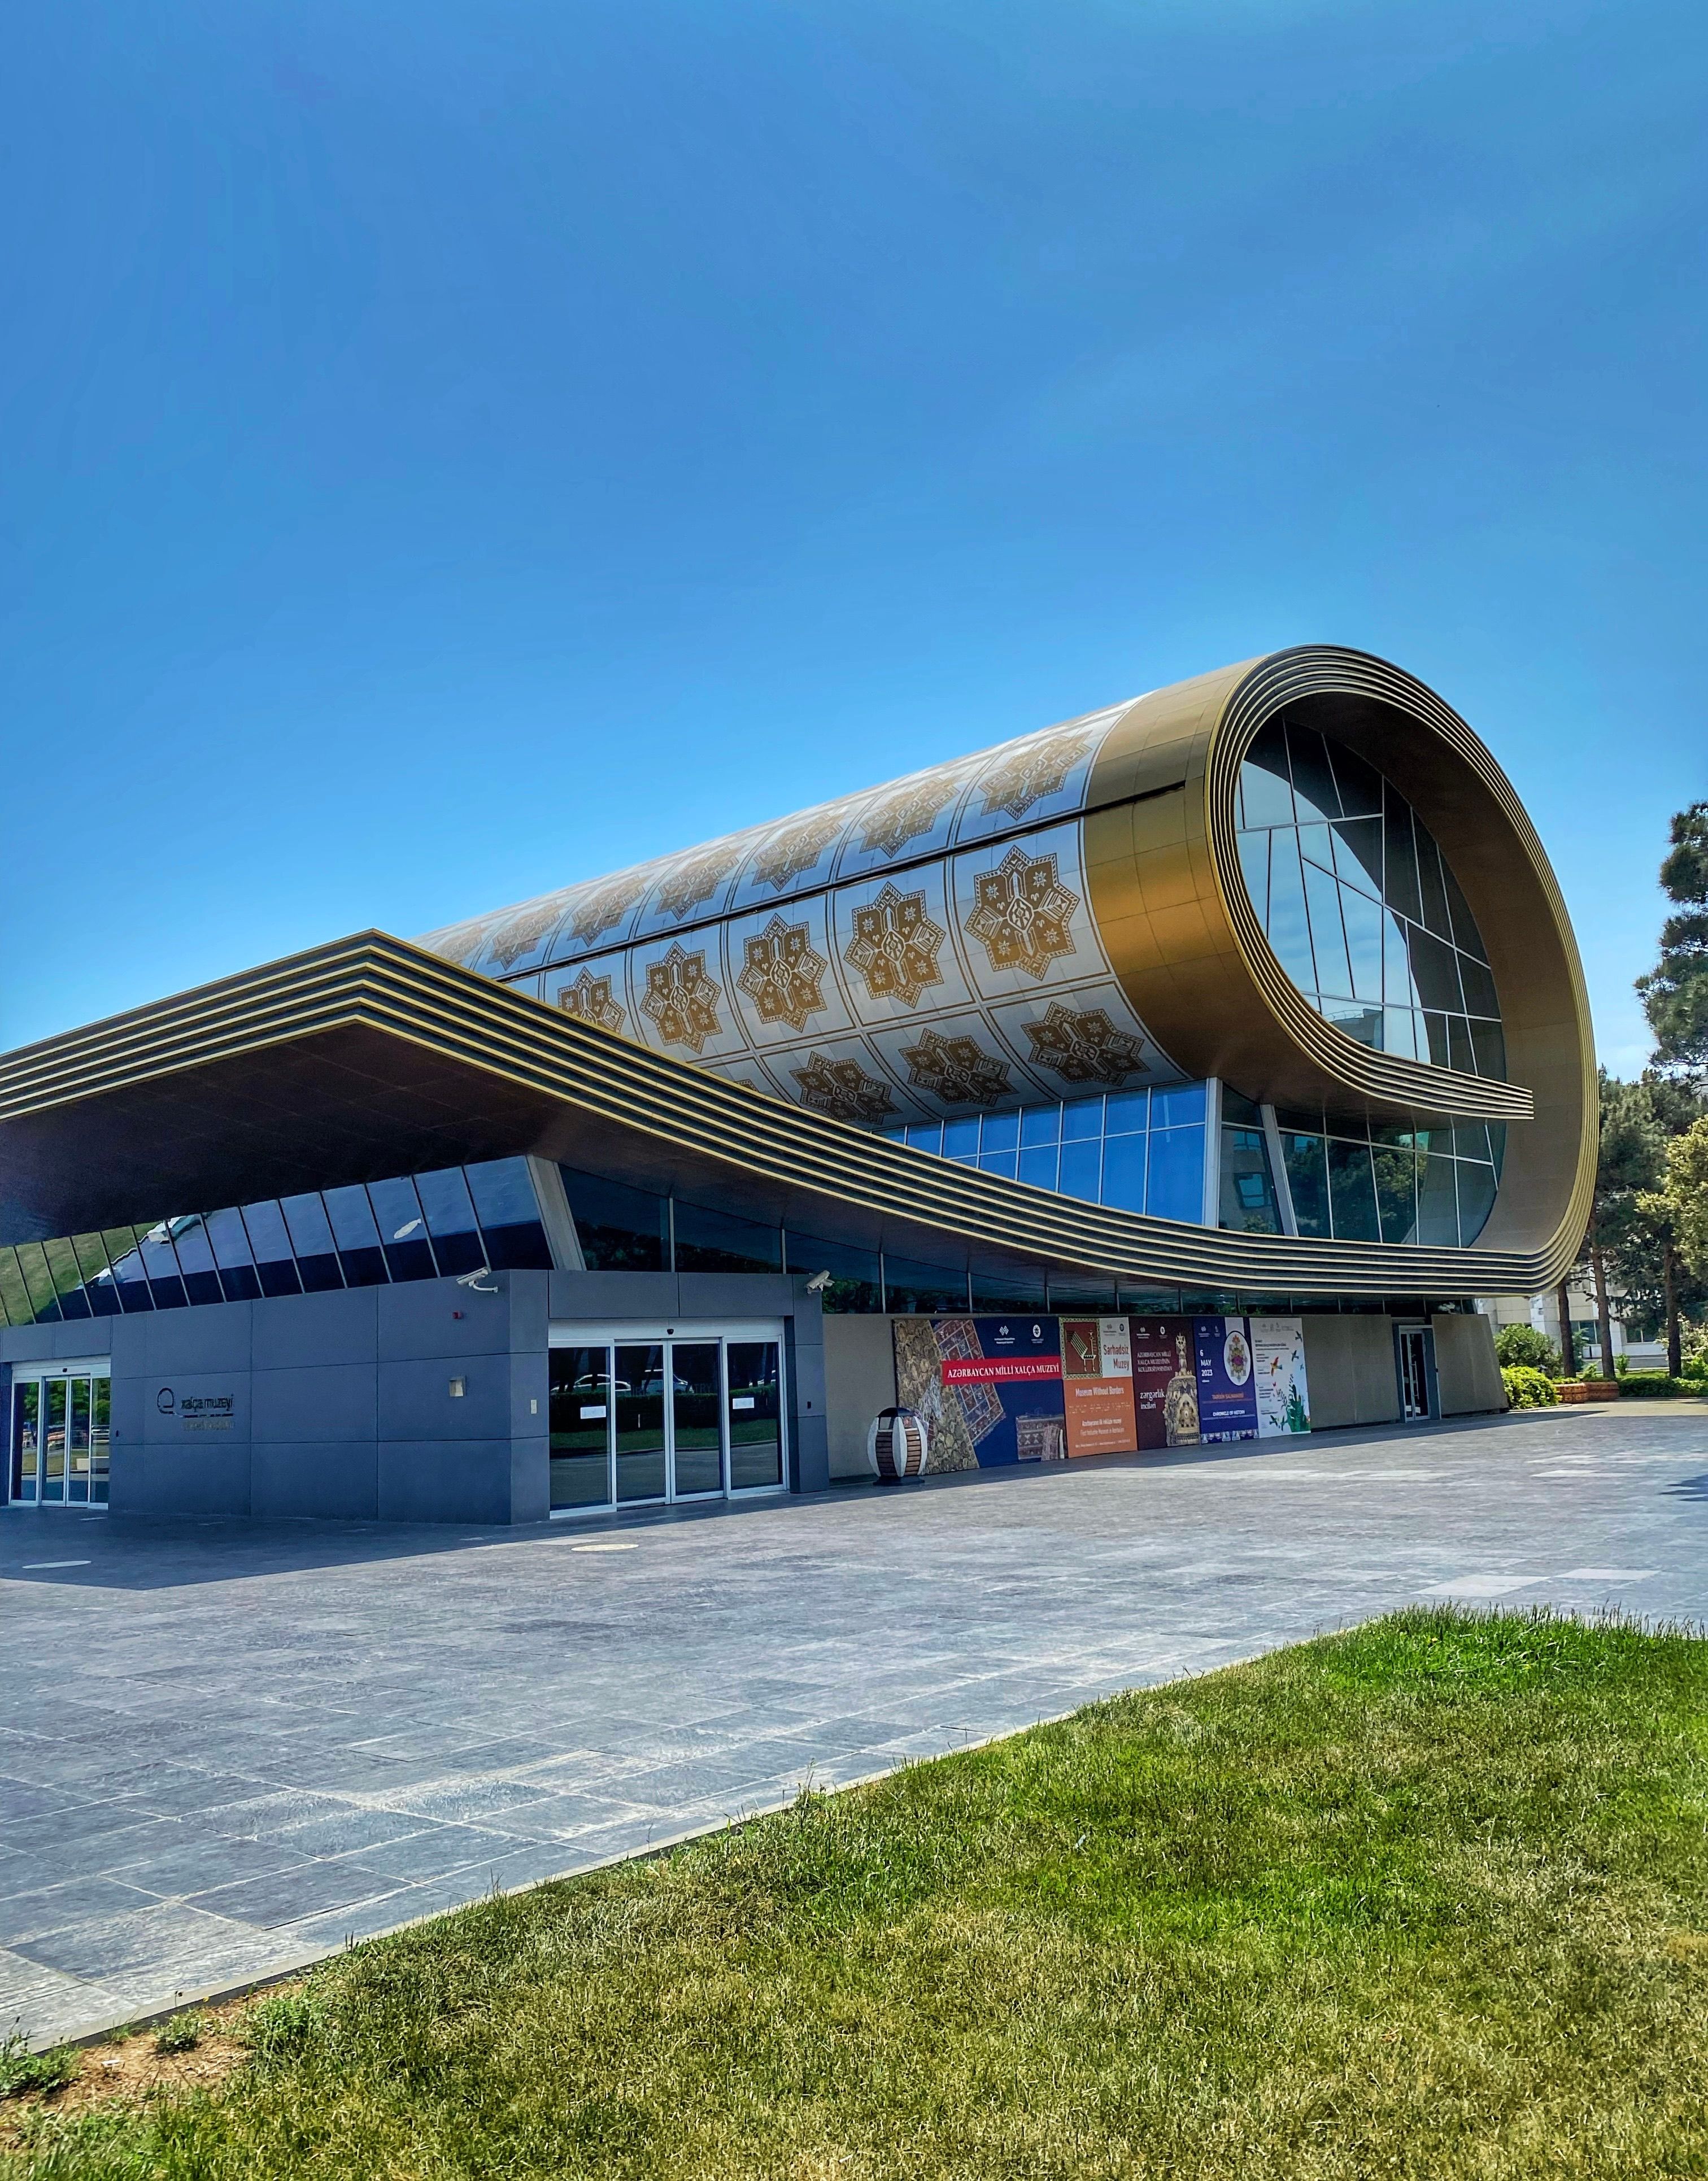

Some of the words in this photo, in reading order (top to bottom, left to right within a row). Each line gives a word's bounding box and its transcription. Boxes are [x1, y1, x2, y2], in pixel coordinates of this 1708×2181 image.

[948, 1367, 994, 1378] AZƏRBAYCAN
[995, 1365, 1014, 1376] MİLLİ
[1015, 1365, 1035, 1376] XALÇA
[1036, 1363, 1060, 1373] MUZEYİ
[1113, 1358, 1130, 1371] Muzey
[1075, 1388, 1092, 1397] Museum
[1092, 1386, 1109, 1395] Without
[1109, 1386, 1125, 1395] Borders
